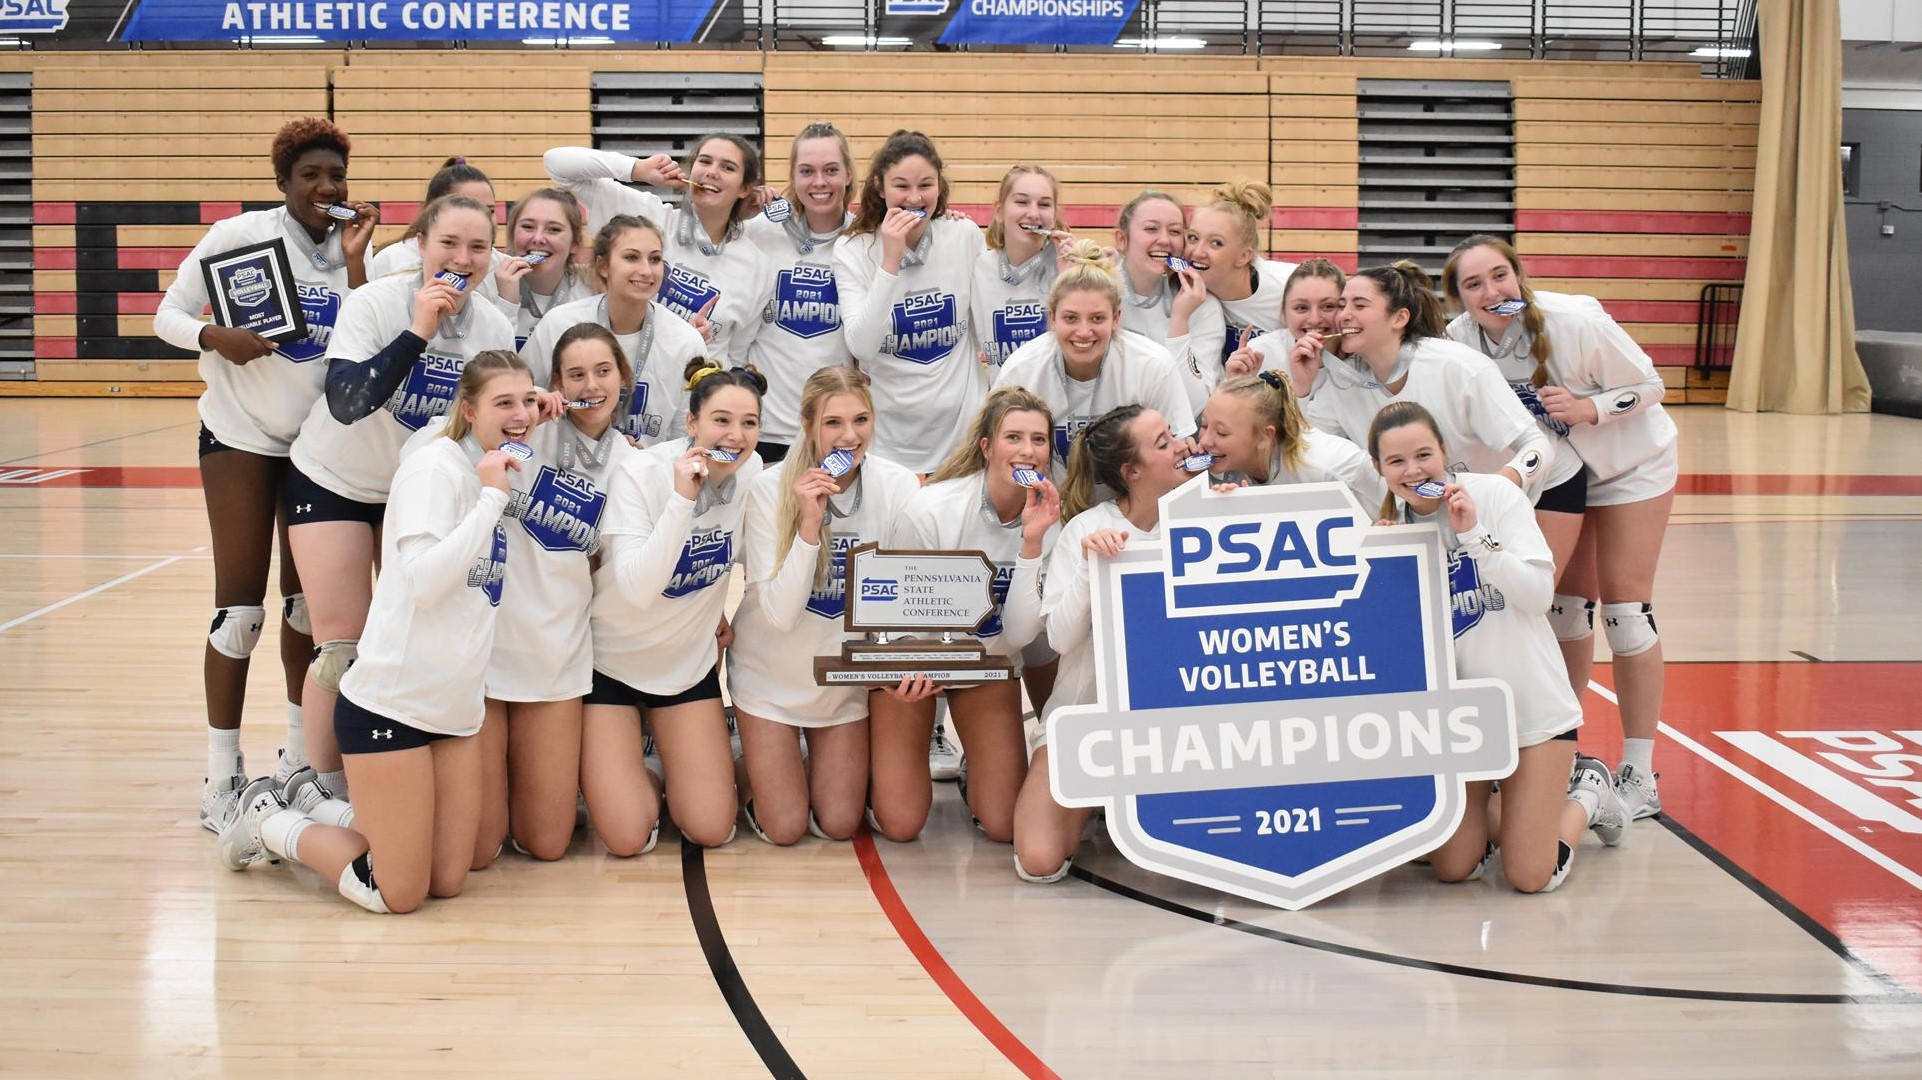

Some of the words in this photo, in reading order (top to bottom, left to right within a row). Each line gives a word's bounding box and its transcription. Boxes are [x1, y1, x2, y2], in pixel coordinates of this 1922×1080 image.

[0, 0, 64, 16] SAC
[971, 0, 1124, 17] CHAMPIONSHIPS
[222, 2, 387, 30] ATHLETIC
[402, 2, 630, 30] CONFERENCE
[236, 270, 255, 279] PSAC
[672, 267, 709, 290] PSAC
[794, 267, 831, 279] PSAC
[299, 286, 328, 298] SAC
[666, 287, 694, 305] 2021
[796, 290, 822, 300] 2021
[905, 292, 942, 309] PSAC
[249, 312, 265, 320] MOST
[1005, 305, 1040, 317] PSAC
[263, 314, 282, 324] PLAYER
[914, 318, 938, 330] 2021
[1011, 329, 1036, 339] 2021
[427, 354, 464, 373] PSAC
[426, 383, 454, 397] 2021
[557, 468, 595, 494] PSAC
[554, 494, 581, 514] 2021
[691, 530, 724, 548] PSAC
[831, 538, 860, 550] SAC
[1169, 516, 1357, 577] PSAC
[904, 574, 981, 583] PENNSYLVANIA
[861, 585, 898, 595] PSAC
[903, 586, 935, 594] STATE
[903, 598, 954, 606] ATHLETIC
[902, 608, 970, 617] CONFERENCE
[1199, 621, 1351, 655] WOMEN'S
[867, 672, 911, 680] VOLLEYBA
[913, 671, 951, 679] CAMPION
[1178, 655, 1376, 693] VOLLEYBALL
[1077, 705, 1484, 778] CHAMPIONS
[1255, 807, 1321, 835] 2021
